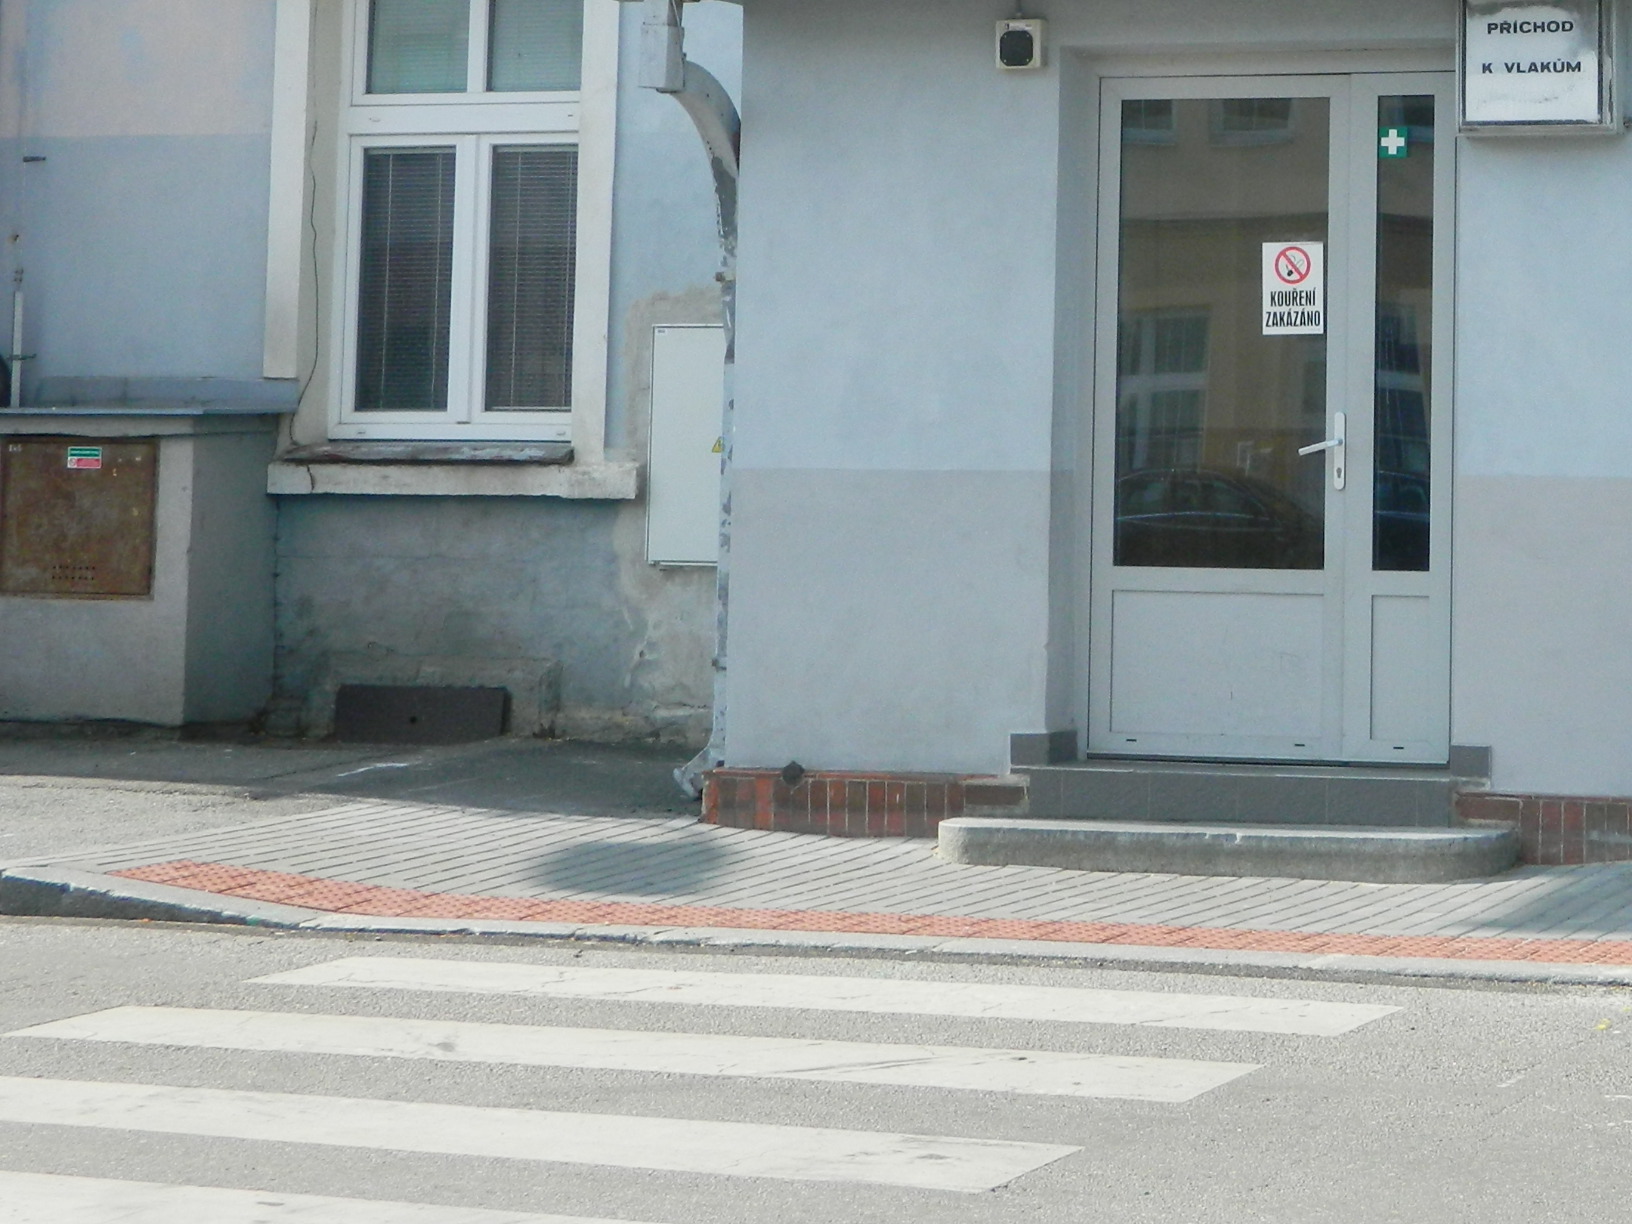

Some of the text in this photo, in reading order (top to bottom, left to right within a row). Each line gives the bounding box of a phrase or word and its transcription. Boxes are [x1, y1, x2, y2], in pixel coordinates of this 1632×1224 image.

[1487, 19, 1574, 35] PŘÍCHOD
[1482, 58, 1582, 74] K VLAKŮM
[1270, 287, 1317, 307] KOUŘENÍ
[1265, 307, 1321, 327] ZAKÁZÁNO
